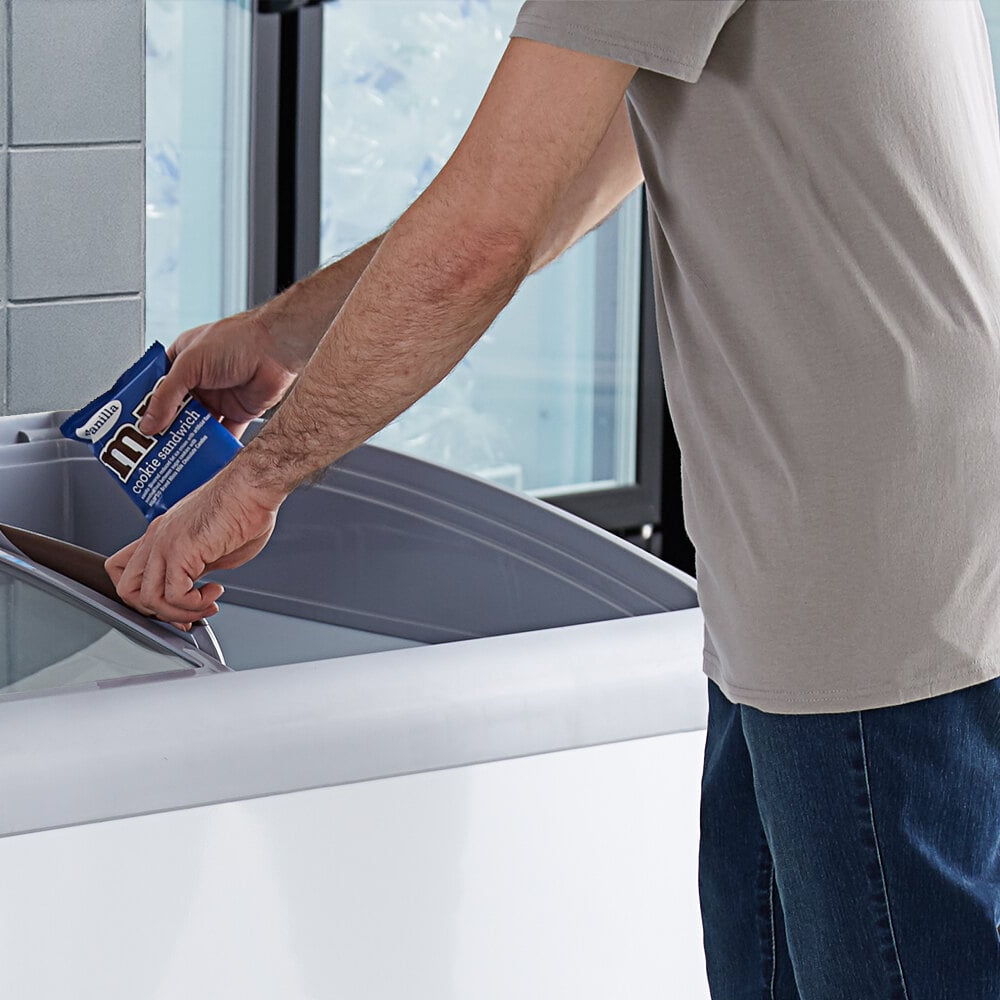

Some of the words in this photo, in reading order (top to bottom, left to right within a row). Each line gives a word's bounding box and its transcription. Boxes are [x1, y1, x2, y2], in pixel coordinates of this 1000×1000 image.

[84, 404, 119, 437] Vanilla
[132, 457, 161, 495] cookie
[158, 409, 201, 460] sandwich
